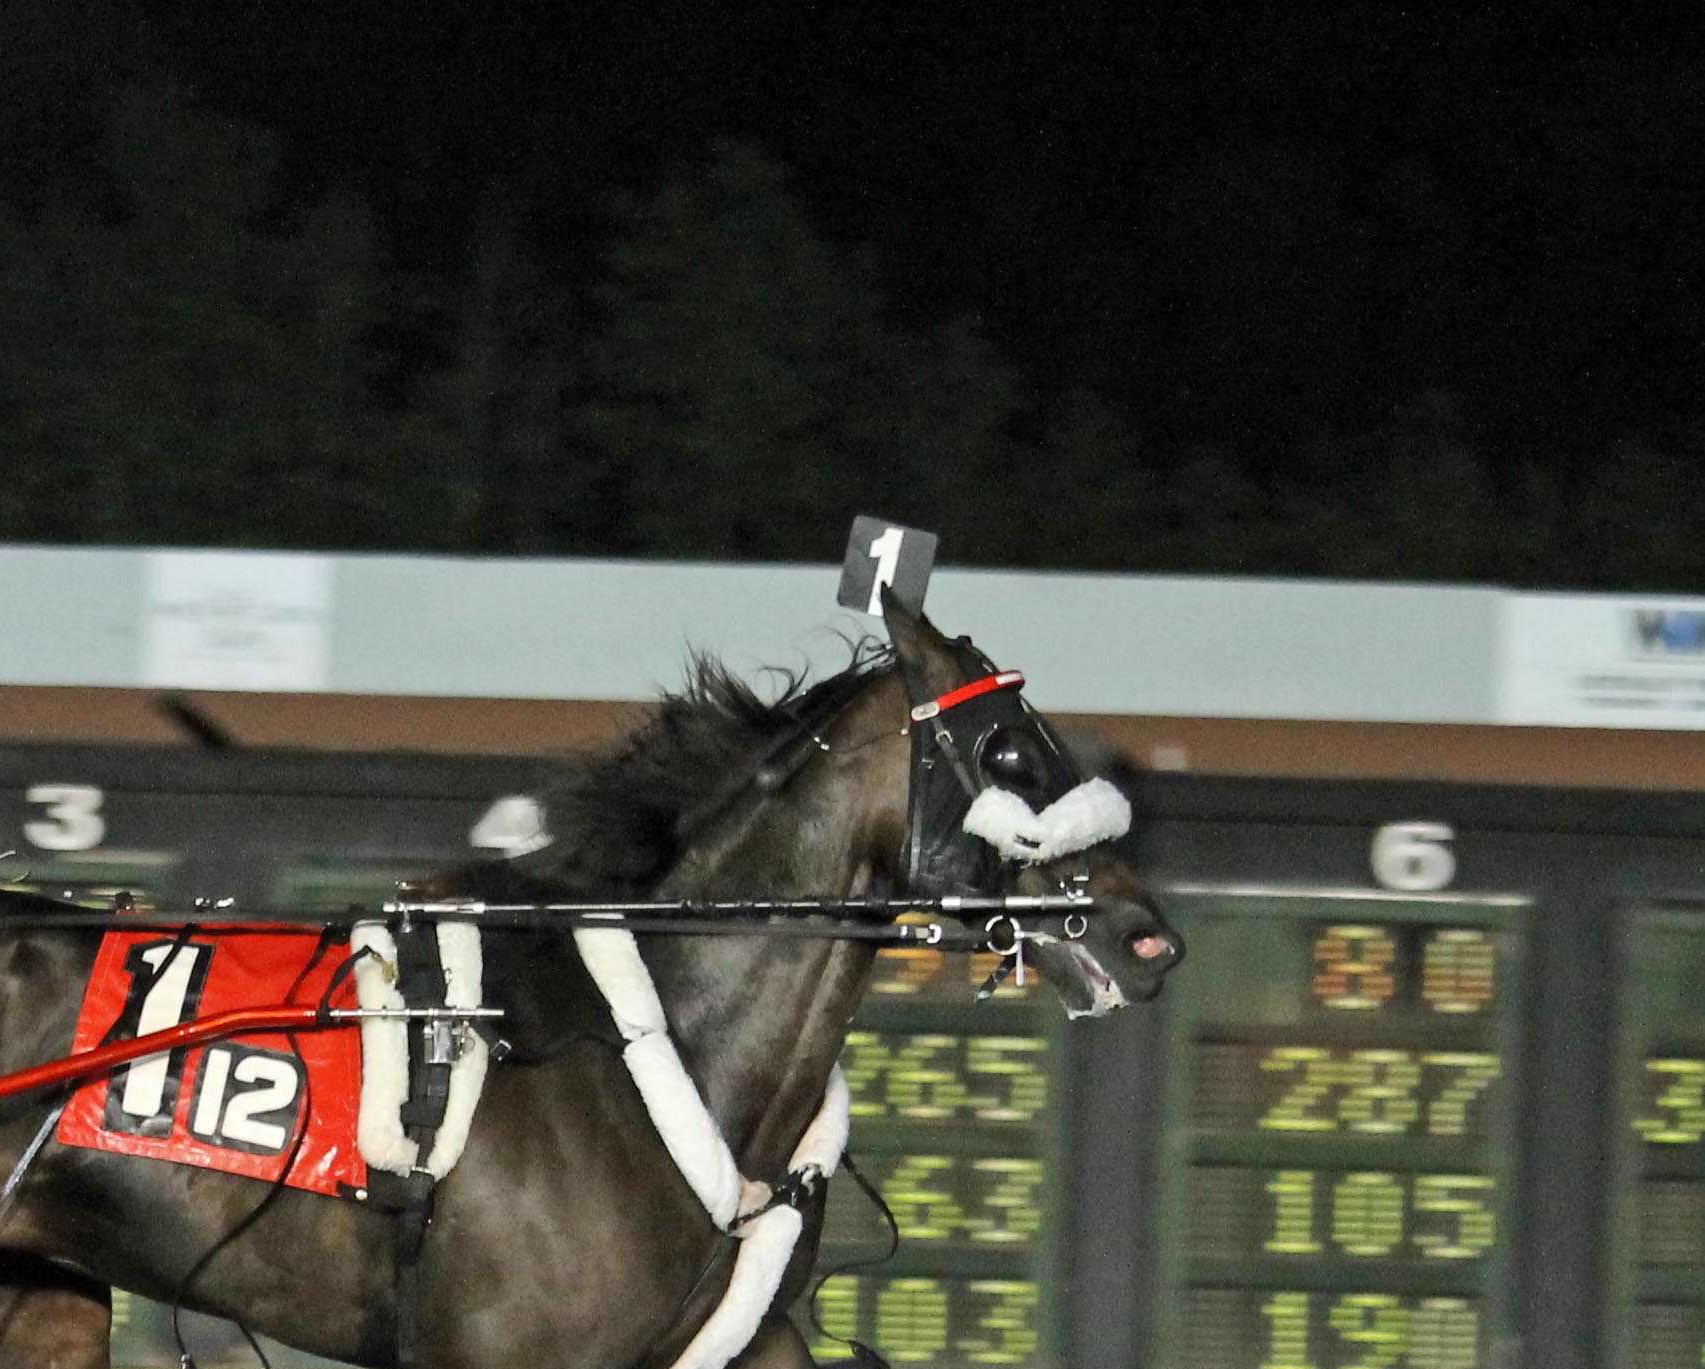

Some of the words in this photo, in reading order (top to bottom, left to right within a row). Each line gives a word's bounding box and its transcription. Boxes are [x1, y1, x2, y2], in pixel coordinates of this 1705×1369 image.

[867, 528, 905, 617] 1
[24, 783, 106, 850] 3
[469, 795, 554, 858] 4
[1370, 821, 1457, 892] 6
[1311, 925, 1494, 1013] 80
[121, 942, 202, 1118] 1
[193, 1048, 299, 1150] 12
[1258, 1048, 1501, 1135] 287
[1263, 1170, 1495, 1258] 105
